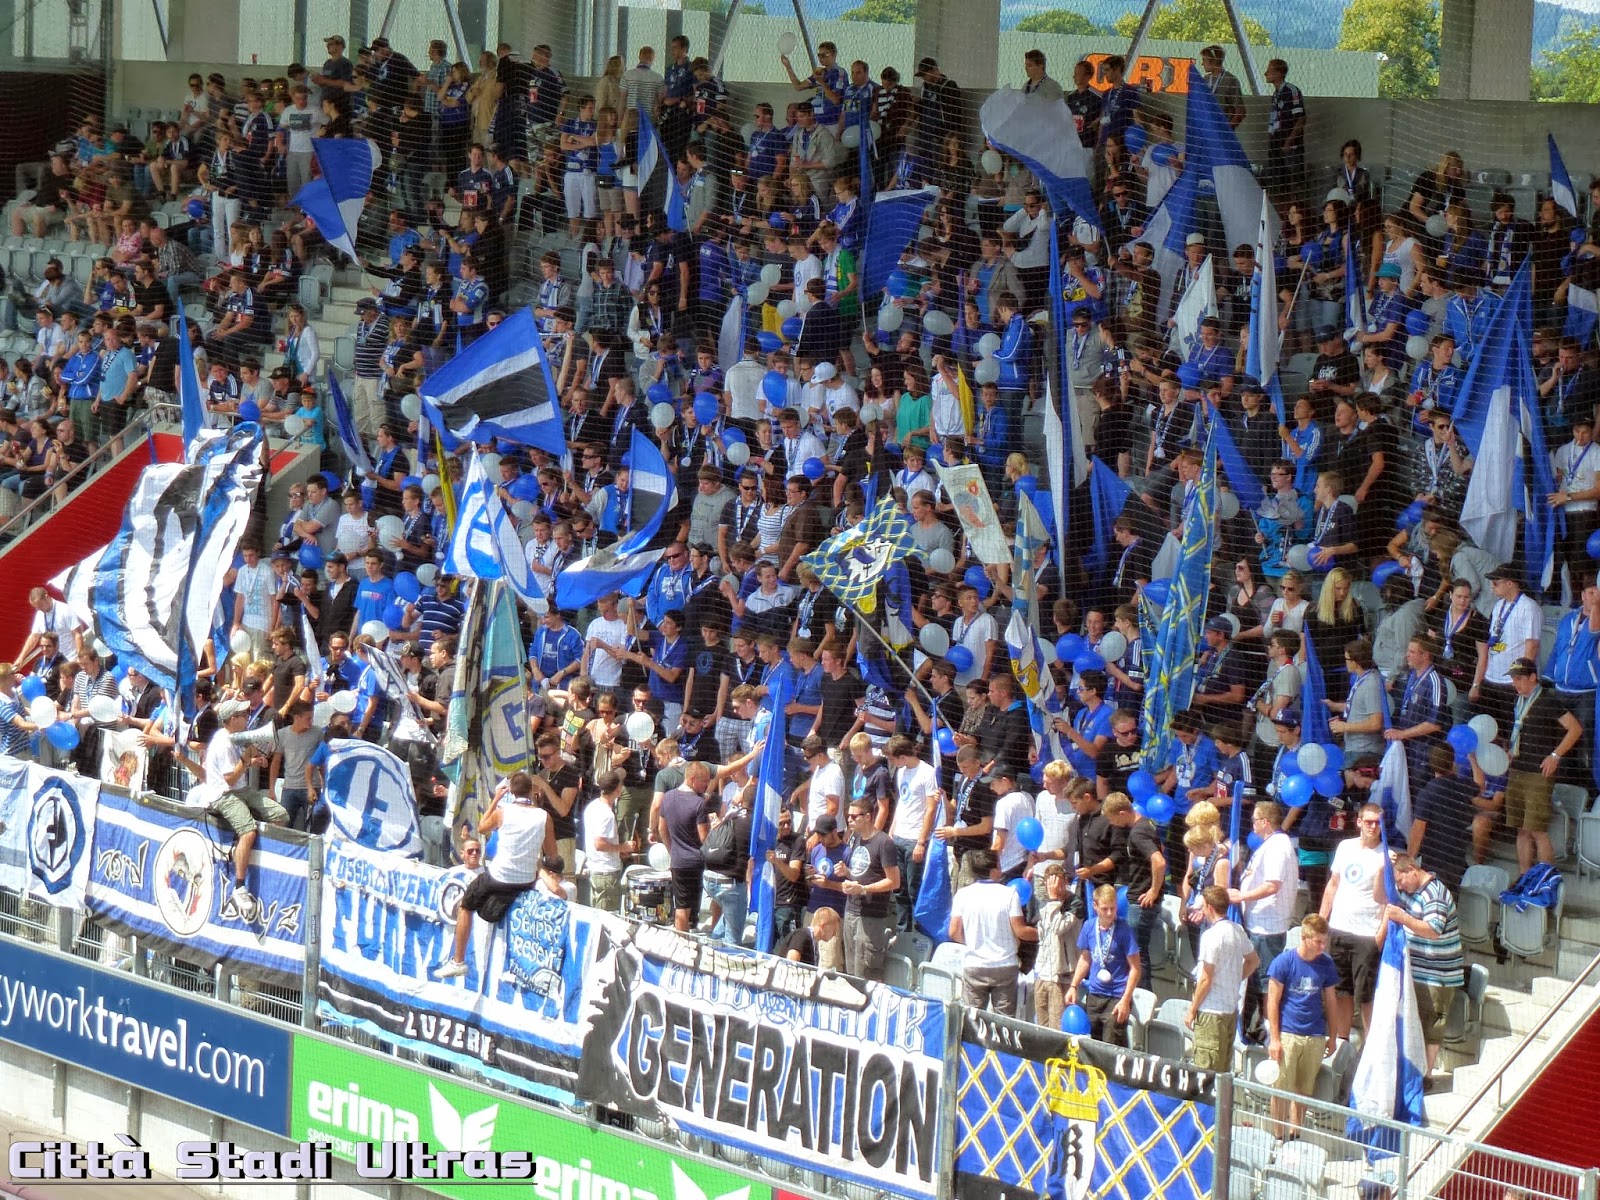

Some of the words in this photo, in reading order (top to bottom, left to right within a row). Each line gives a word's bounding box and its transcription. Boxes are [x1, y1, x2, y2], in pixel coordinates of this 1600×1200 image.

[404, 1011, 492, 1061] LUZERN
[976, 1016, 1024, 1051] DARK
[308, 1080, 419, 1145] erima
[628, 992, 938, 1183] GENERATION
